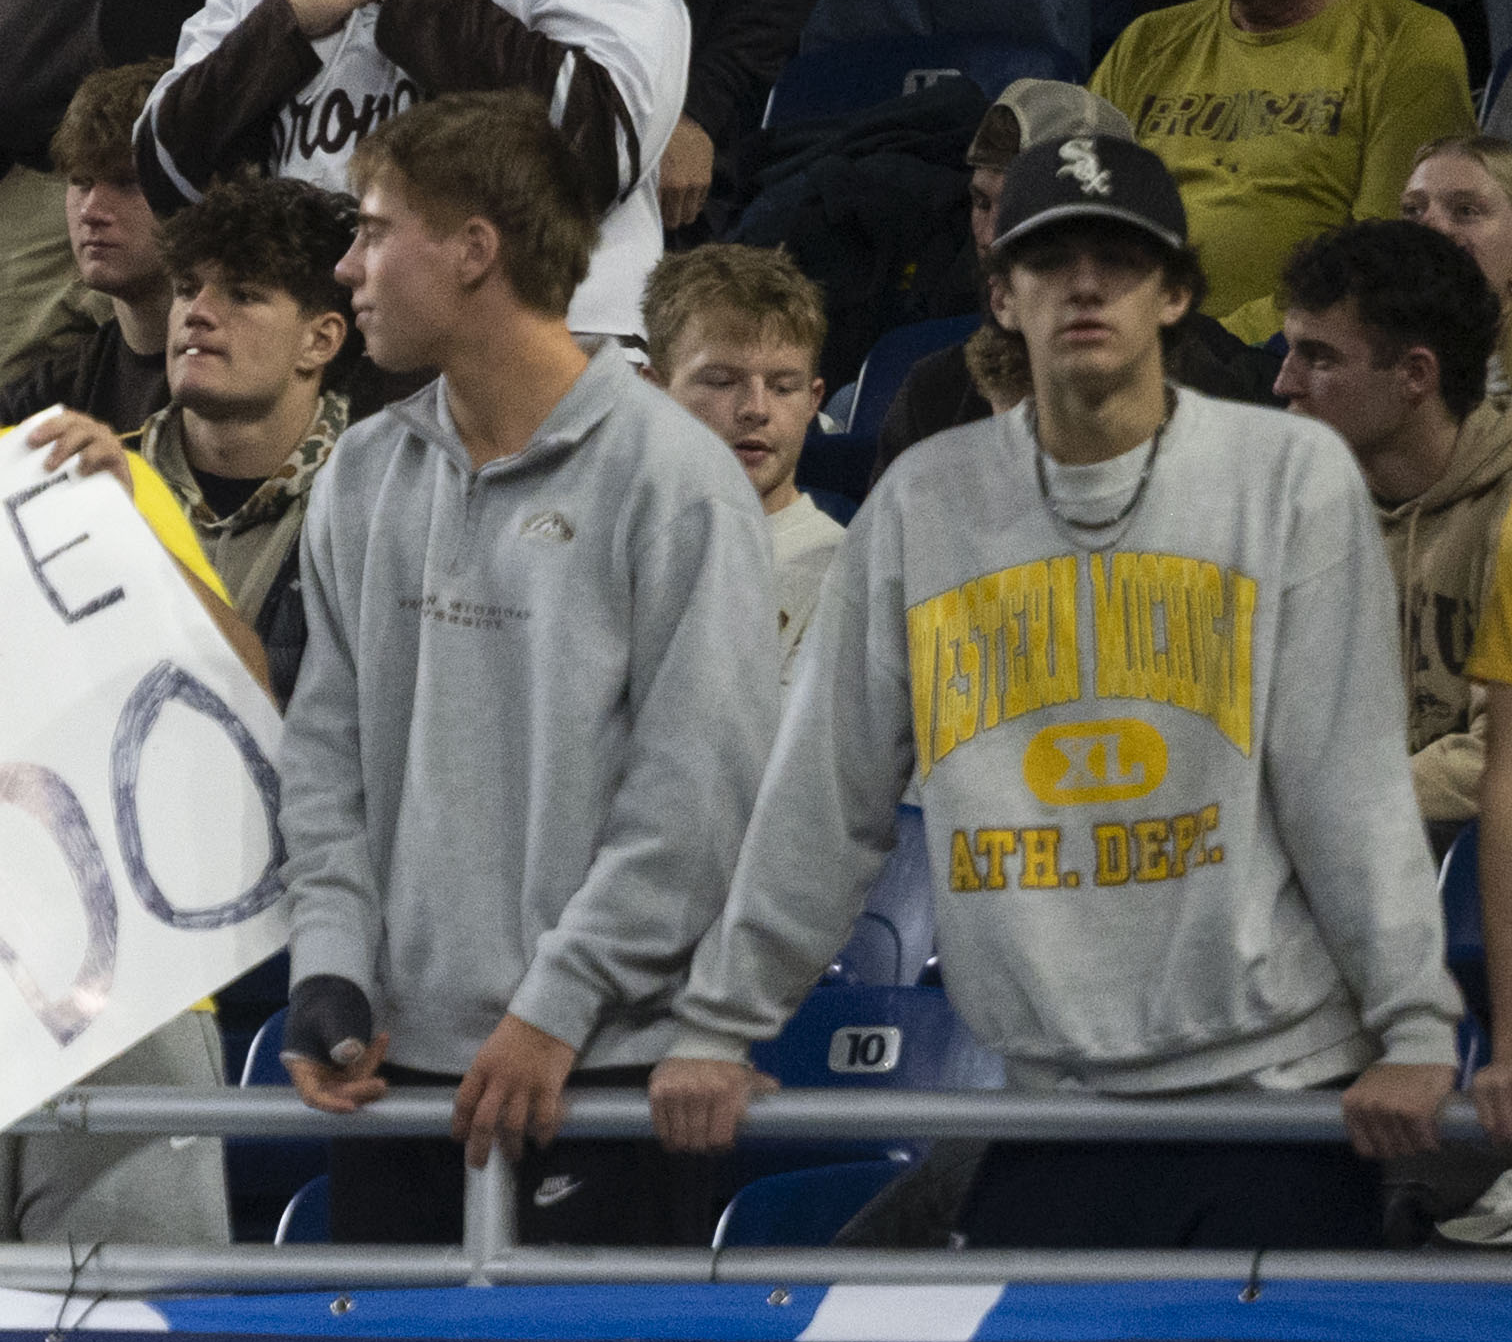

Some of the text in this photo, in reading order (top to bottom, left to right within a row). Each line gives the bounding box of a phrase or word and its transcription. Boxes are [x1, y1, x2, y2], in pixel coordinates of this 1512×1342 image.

[1053, 731, 1146, 791] XL
[950, 803, 1225, 893] ATH. DEPT.
[847, 1033, 885, 1067] 10
